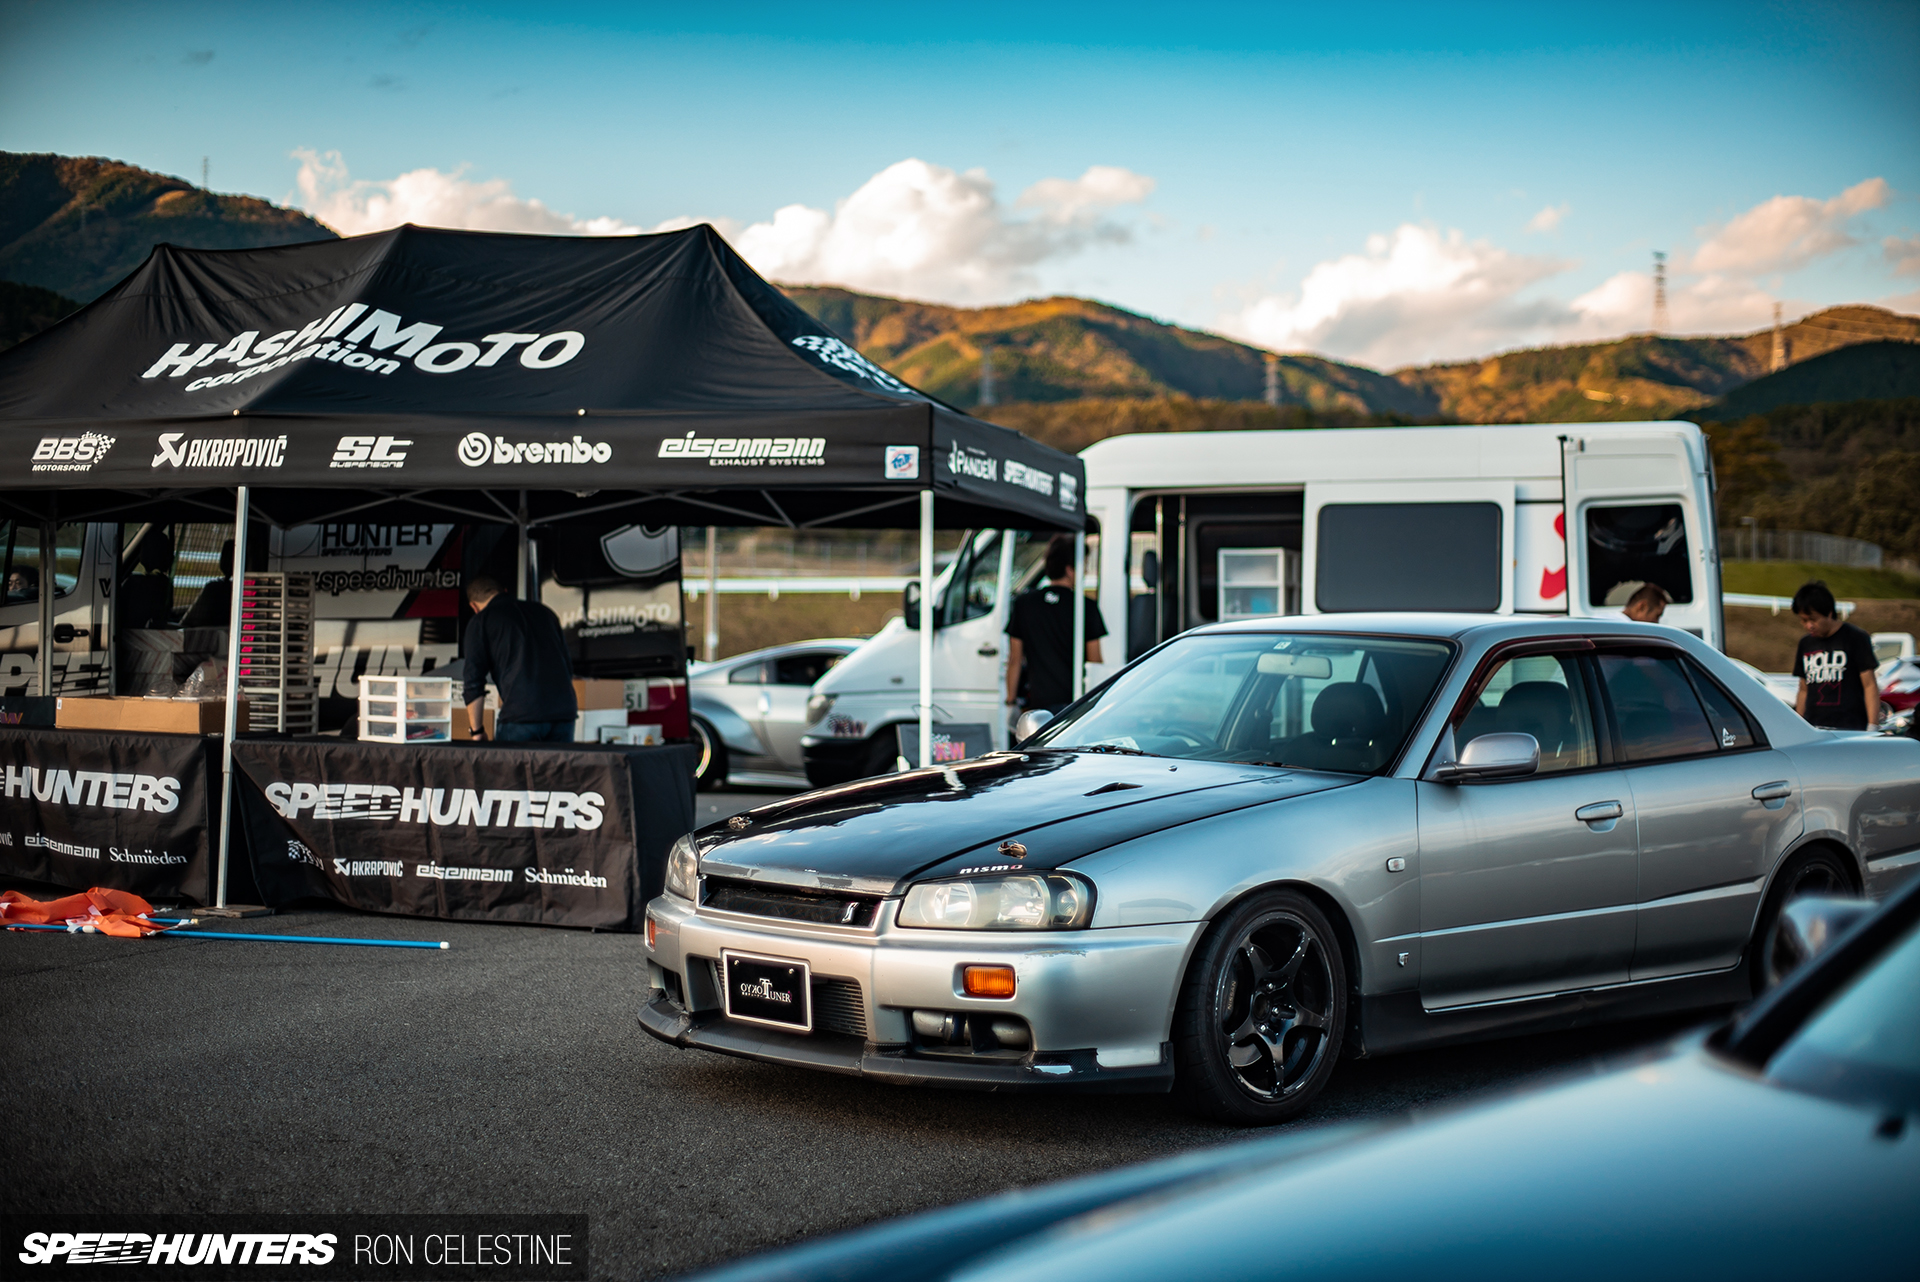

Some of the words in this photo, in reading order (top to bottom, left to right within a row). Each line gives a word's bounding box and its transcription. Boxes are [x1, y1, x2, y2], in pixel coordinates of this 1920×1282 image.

[141, 302, 586, 379] HASHIMOTO
[184, 341, 402, 392] corporation
[31, 437, 98, 462] BBS
[189, 434, 288, 467] AKRAPOVIČ
[493, 436, 612, 464] brembo
[658, 430, 826, 458] eisenmann
[32, 464, 92, 472] MOTORSPORT
[709, 458, 764, 467] EXHAUST
[769, 458, 825, 467] SYSTEMS
[1803, 650, 1848, 673] HOLD
[0, 765, 180, 814] HUNTERS
[265, 782, 606, 830] SPEEDHUNTERS
[24, 832, 100, 859] eisenmann
[351, 860, 404, 877] AKRAPOVIČ
[417, 860, 513, 882] eisenmann
